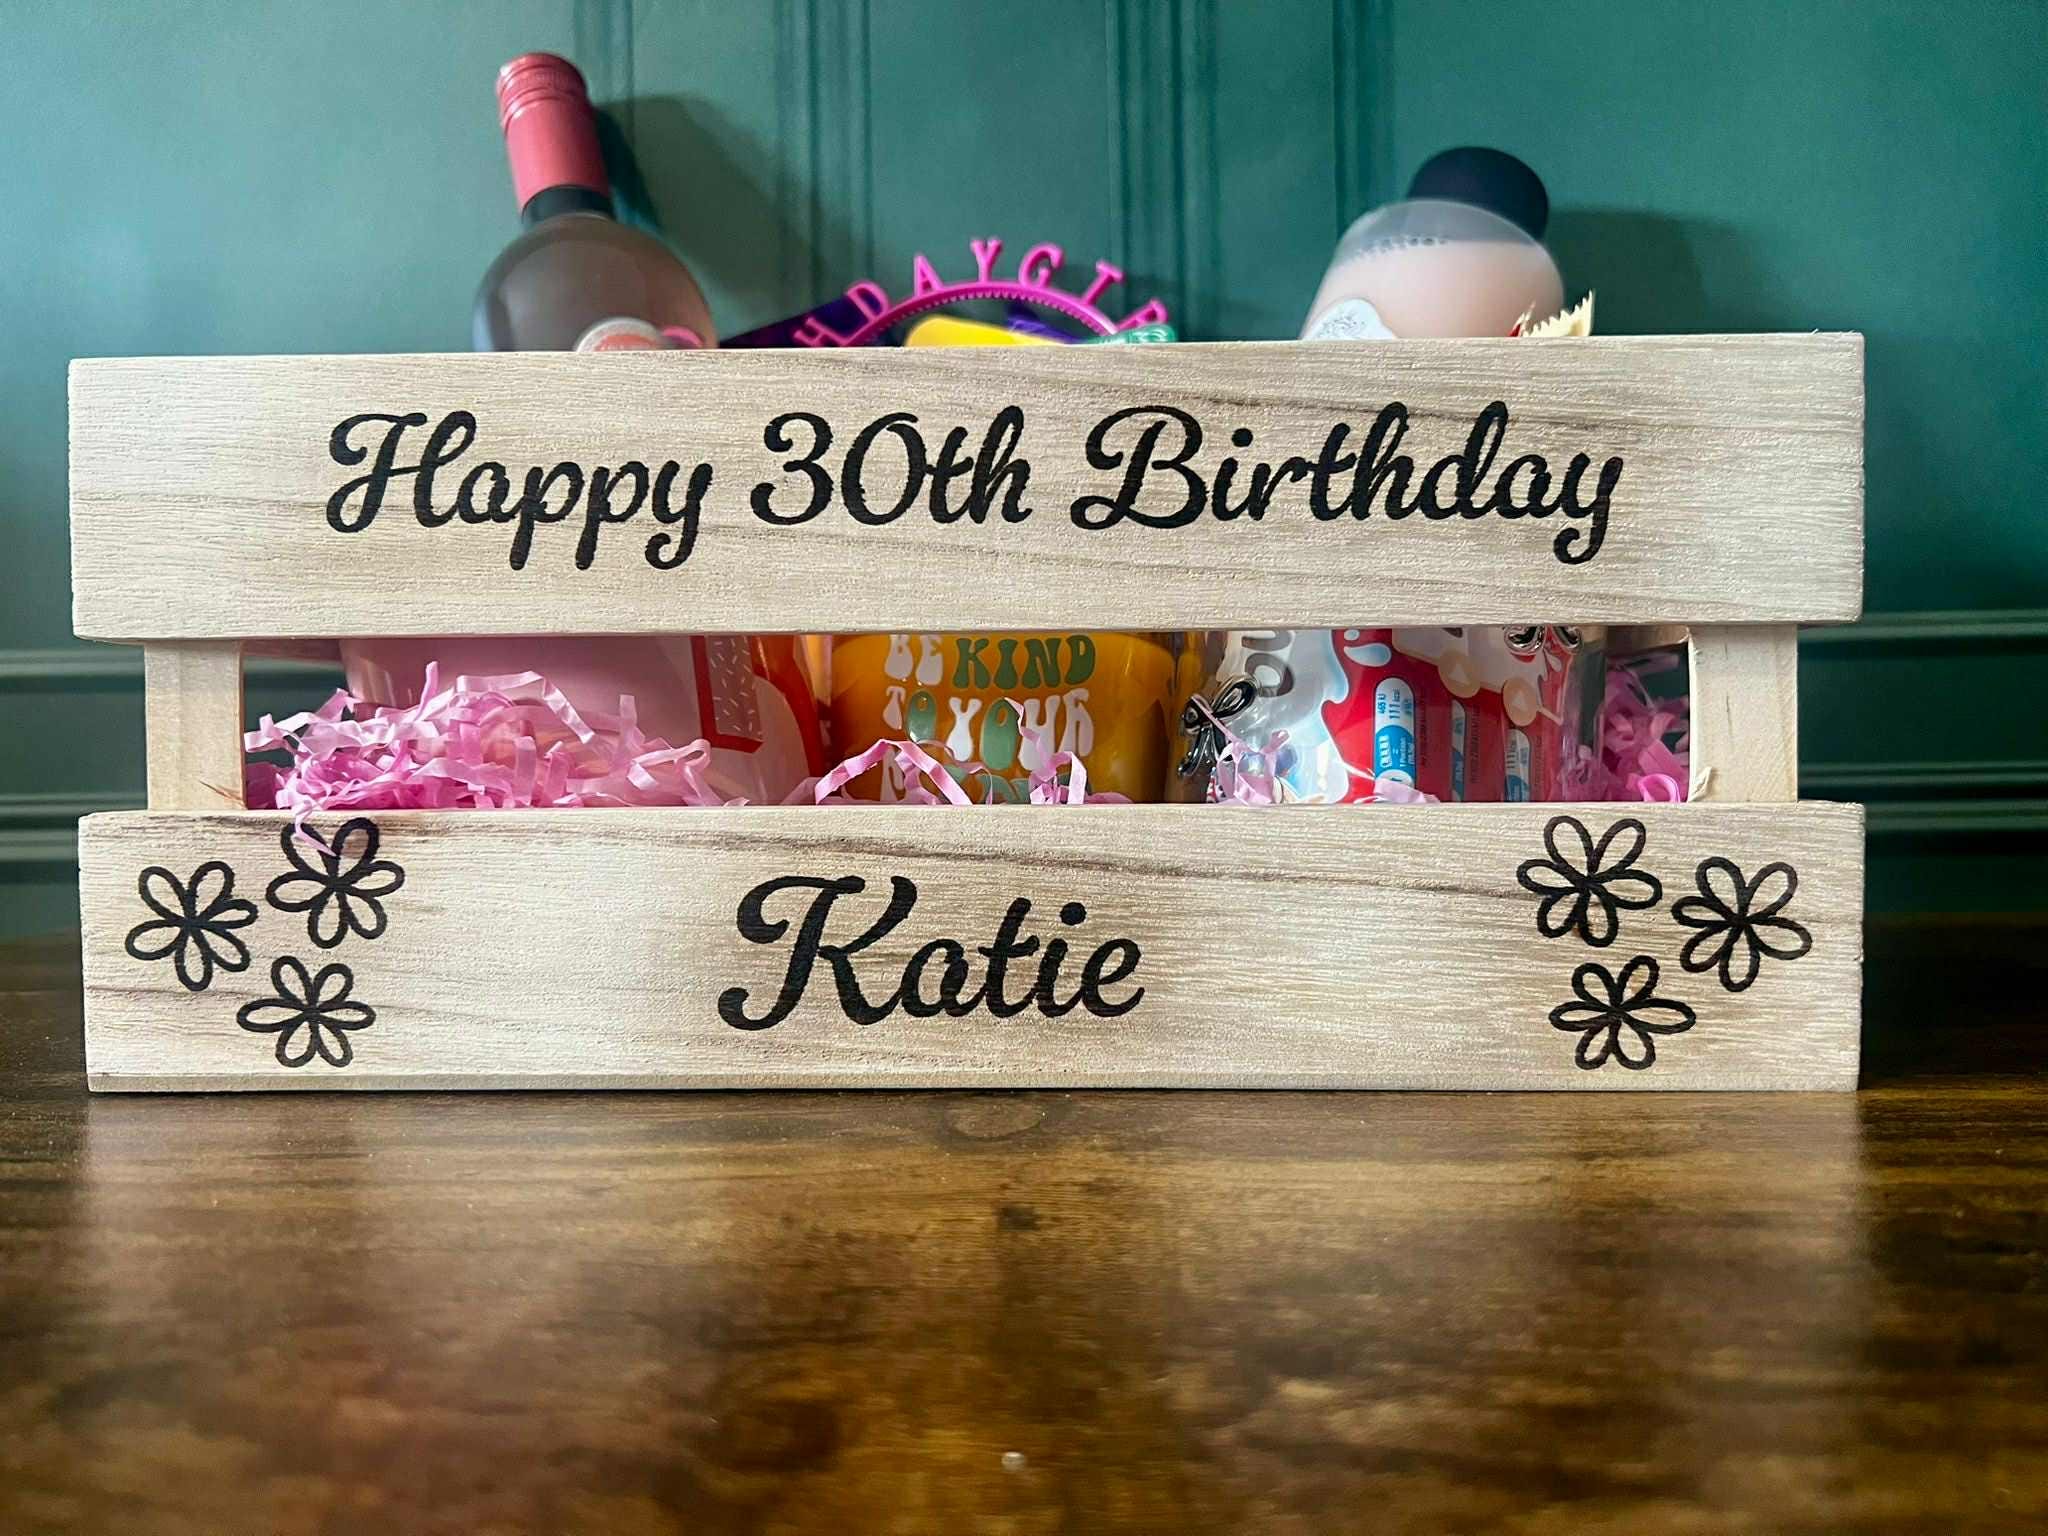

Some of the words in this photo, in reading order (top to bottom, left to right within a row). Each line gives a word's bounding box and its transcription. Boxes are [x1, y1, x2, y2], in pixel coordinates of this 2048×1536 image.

[326, 410, 714, 571] Happy
[750, 405, 1033, 526] 30th
[1069, 400, 1624, 565] Birthday
[884, 635, 944, 686] BE
[952, 634, 1096, 690] KIND
[946, 687, 1095, 772] YOUR
[717, 875, 1146, 1032] Katie
